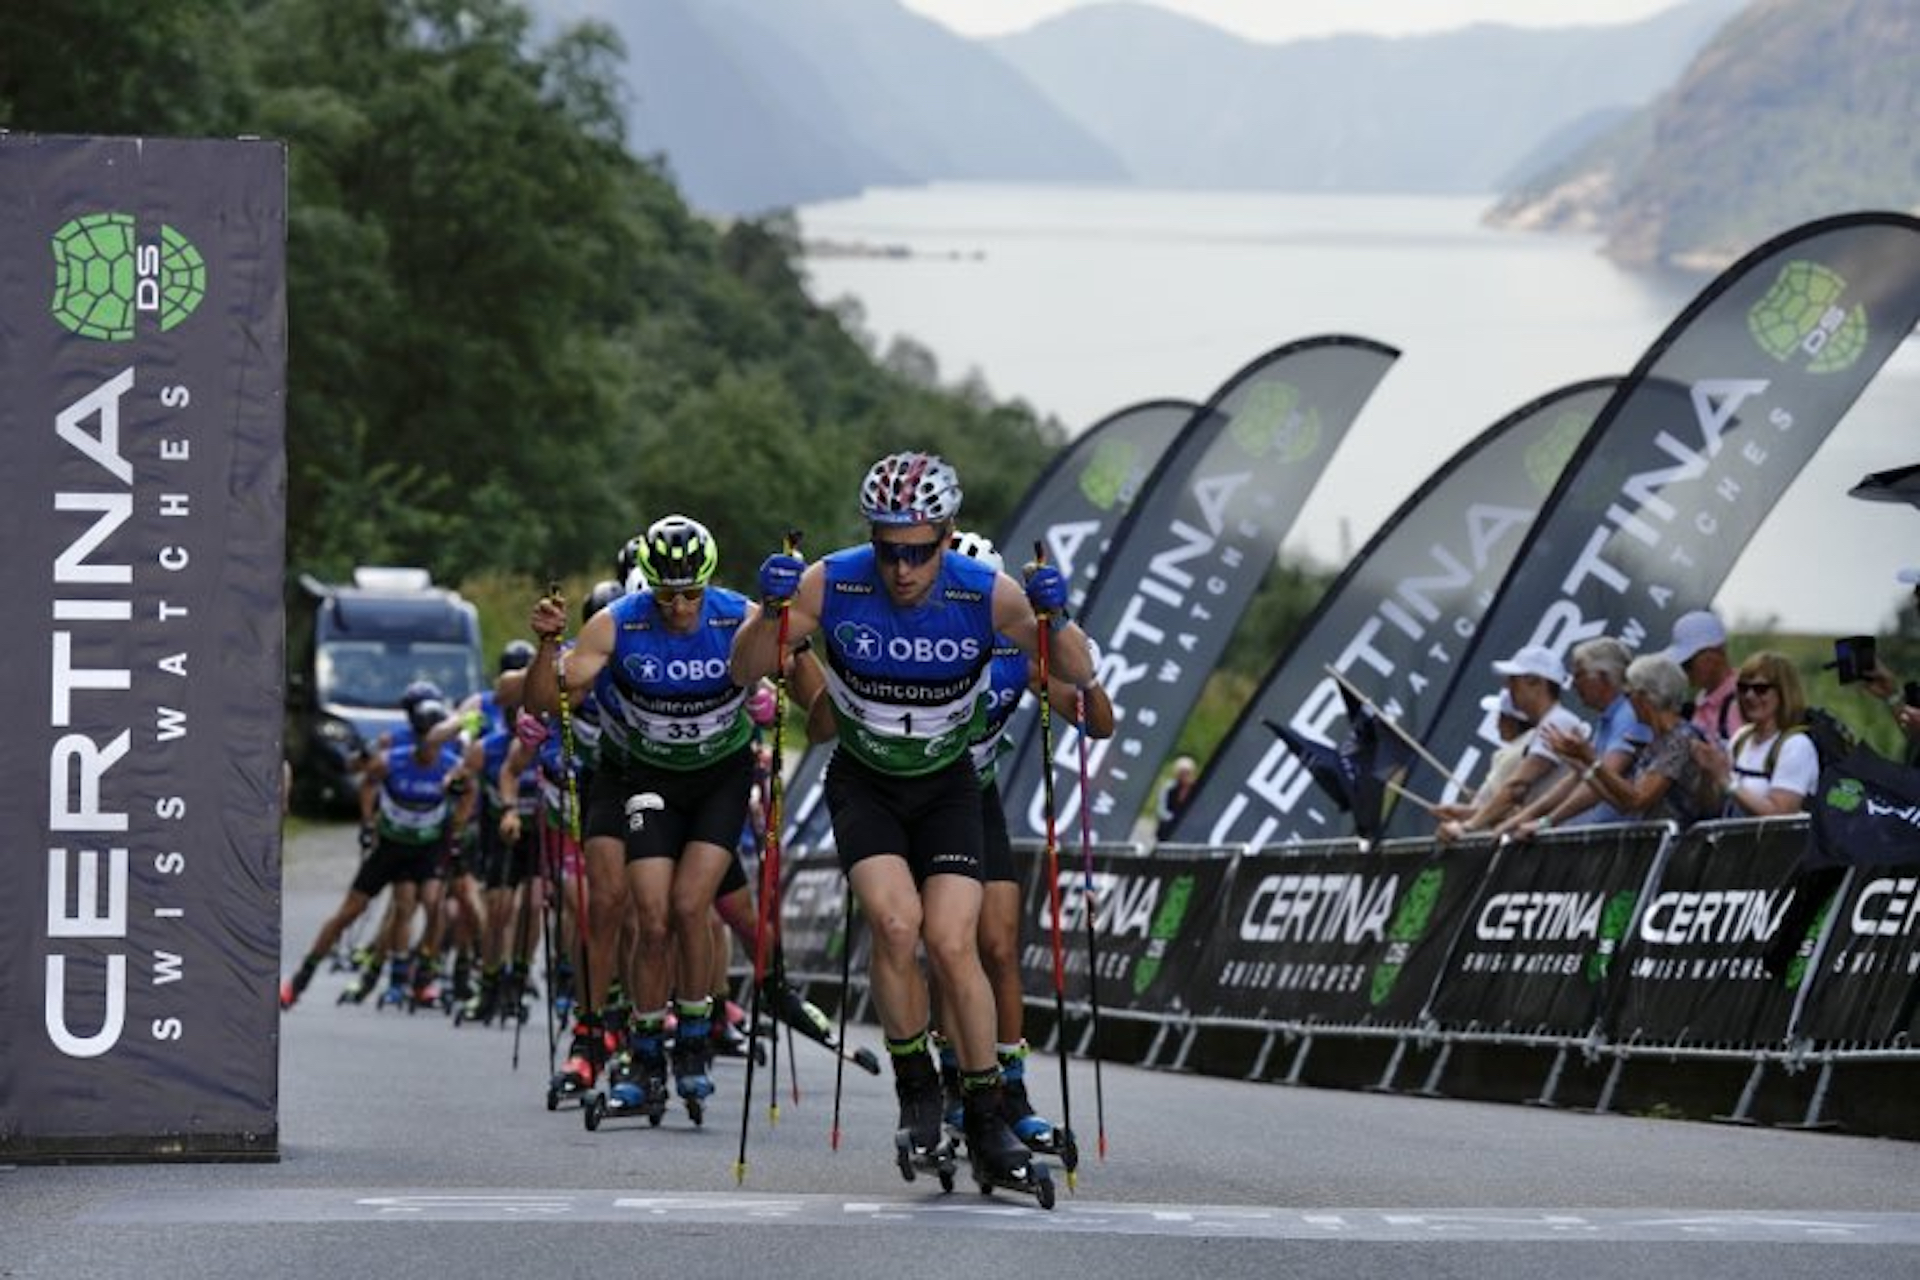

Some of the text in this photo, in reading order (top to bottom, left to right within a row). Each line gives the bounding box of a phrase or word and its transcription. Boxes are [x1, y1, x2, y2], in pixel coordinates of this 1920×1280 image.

[137, 244, 159, 310] DS
[666, 657, 732, 681] OBO
[888, 637, 980, 663] OBOS
[1028, 470, 1252, 838] CERTINA
[45, 365, 135, 1058] CERTINA
[152, 384, 190, 1040] SWISS WATCHES
[667, 723, 701, 738] 33
[897, 712, 913, 735] 1
[1239, 873, 1400, 944] CERTINA
[1476, 891, 1606, 941] CERTINA
